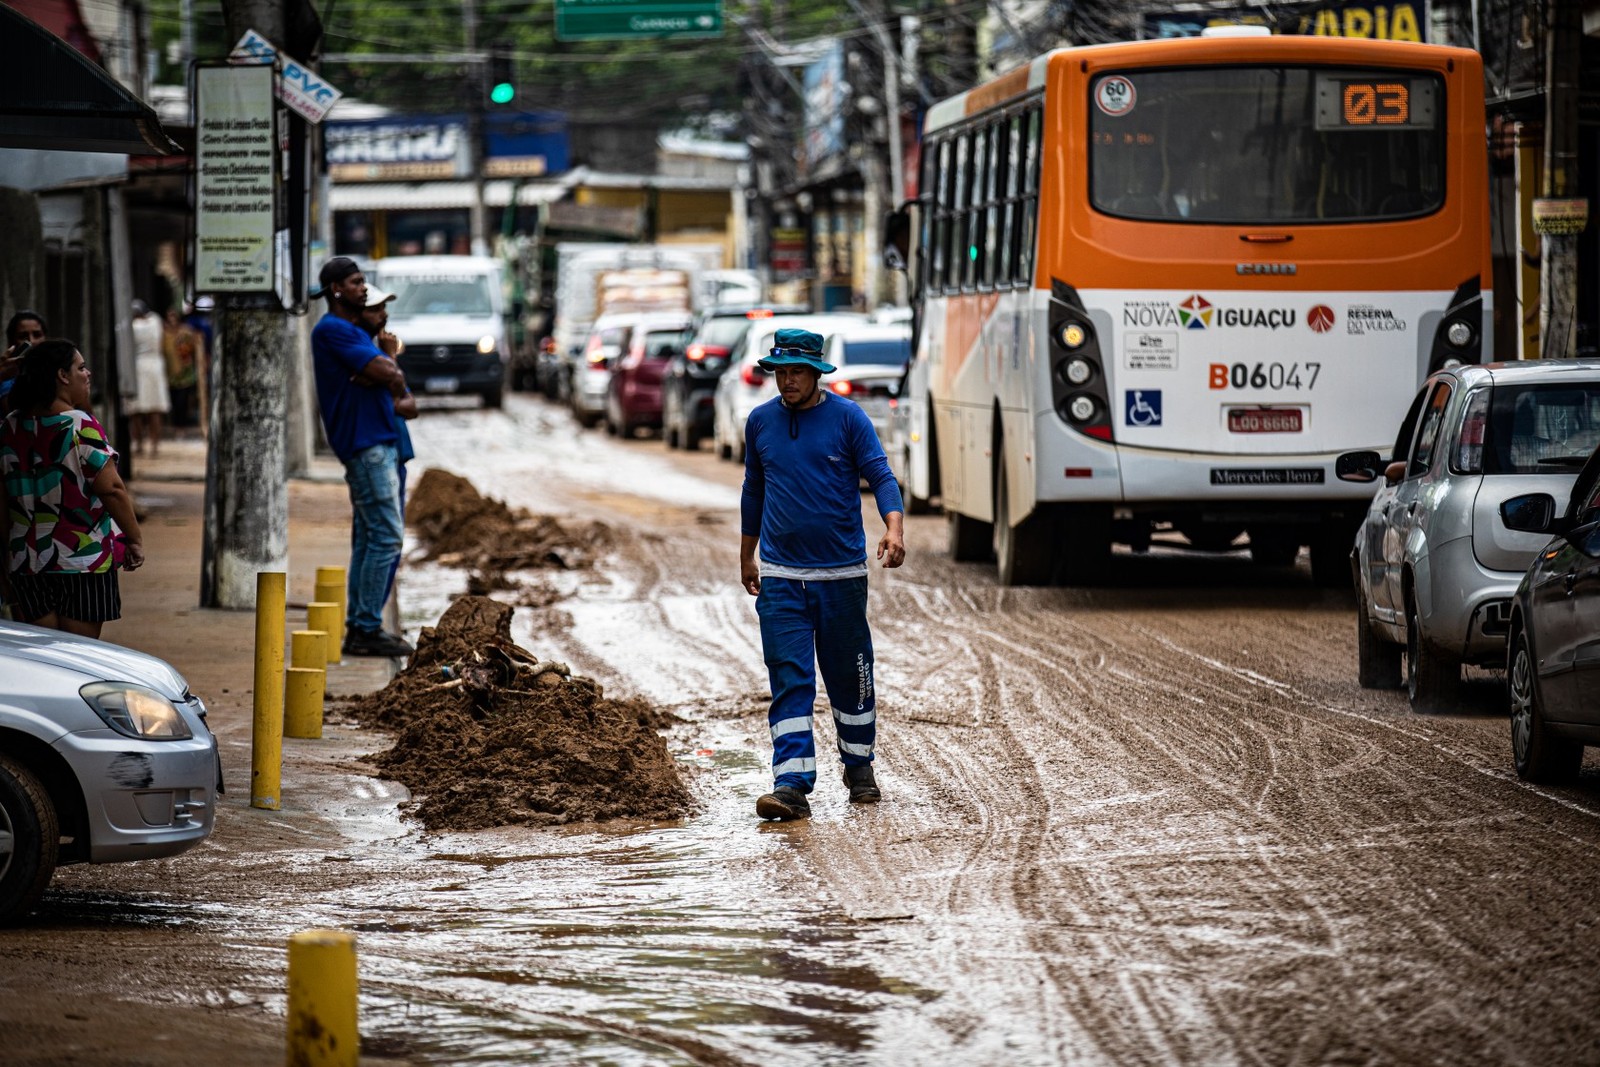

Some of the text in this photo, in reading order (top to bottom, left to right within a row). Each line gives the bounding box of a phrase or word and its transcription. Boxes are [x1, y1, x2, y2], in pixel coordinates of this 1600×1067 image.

[1105, 82, 1126, 96] 60
[1344, 83, 1409, 125] 03
[1124, 308, 1296, 331] NOVA IGUAÇU
[1347, 309, 1394, 319] RESERVA
[1208, 362, 1321, 390] B06047
